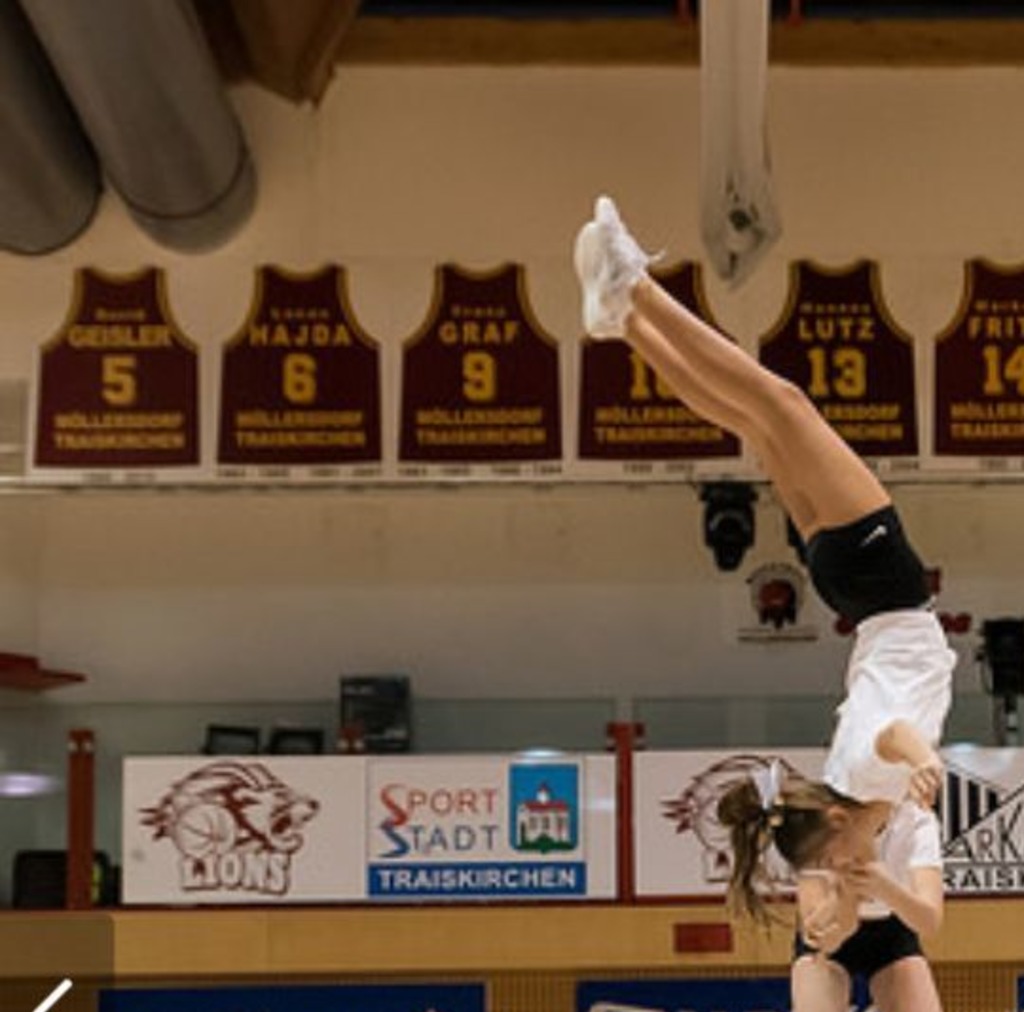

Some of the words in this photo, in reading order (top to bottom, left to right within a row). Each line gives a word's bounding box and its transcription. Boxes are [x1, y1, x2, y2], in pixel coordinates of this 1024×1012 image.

[438, 321, 519, 345] GRAF
[799, 318, 875, 341] LUTZ
[102, 355, 137, 406] 5
[283, 353, 317, 403] 6
[463, 351, 496, 401] 9
[808, 347, 867, 398] 13
[380, 784, 497, 826] SPORT
[380, 820, 498, 857] STADT
[180, 850, 289, 895] LIONS
[378, 867, 576, 891] TRAISKIRCHEN
